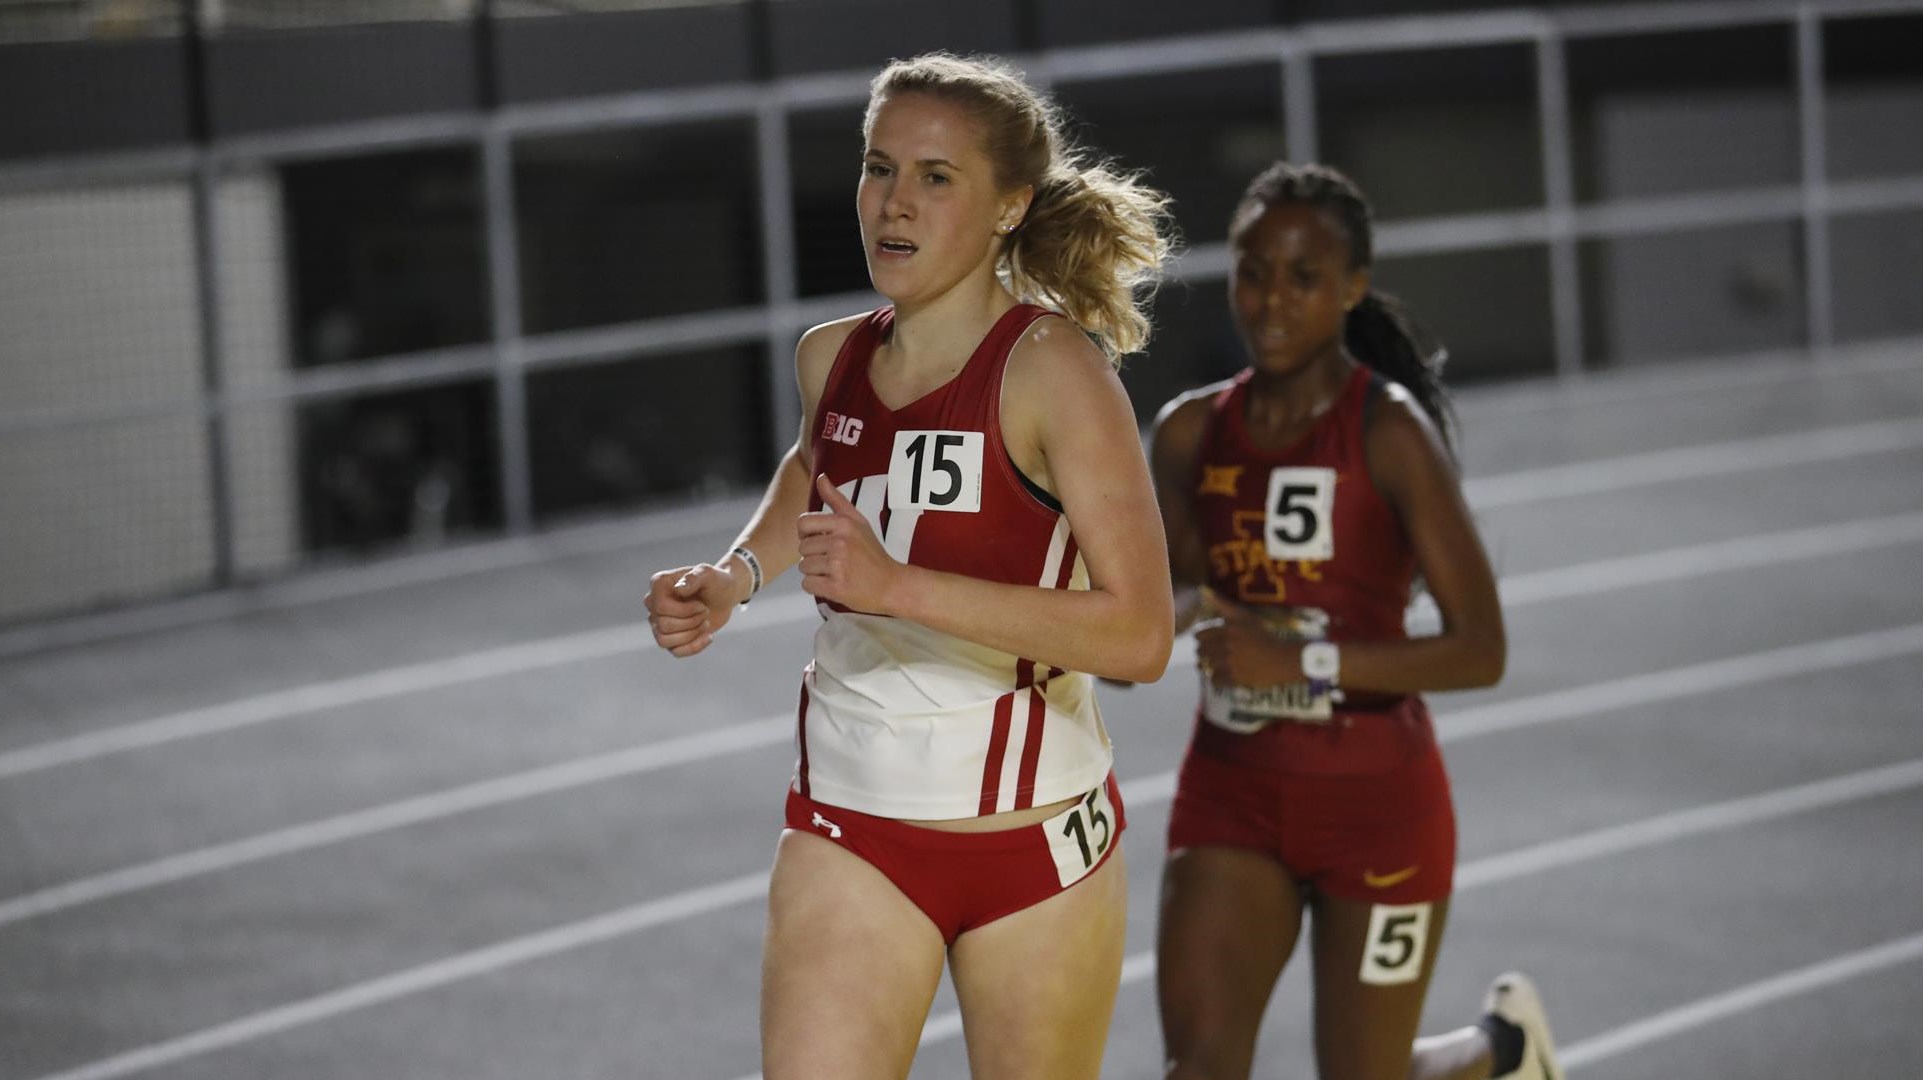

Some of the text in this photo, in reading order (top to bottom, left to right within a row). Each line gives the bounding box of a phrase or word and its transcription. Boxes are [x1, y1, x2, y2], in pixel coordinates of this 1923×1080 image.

[905, 434, 964, 506] 15
[1274, 485, 1318, 545] 5
[1209, 540, 1323, 581] STAE
[1062, 787, 1109, 869] 15
[1373, 913, 1417, 969] 5
